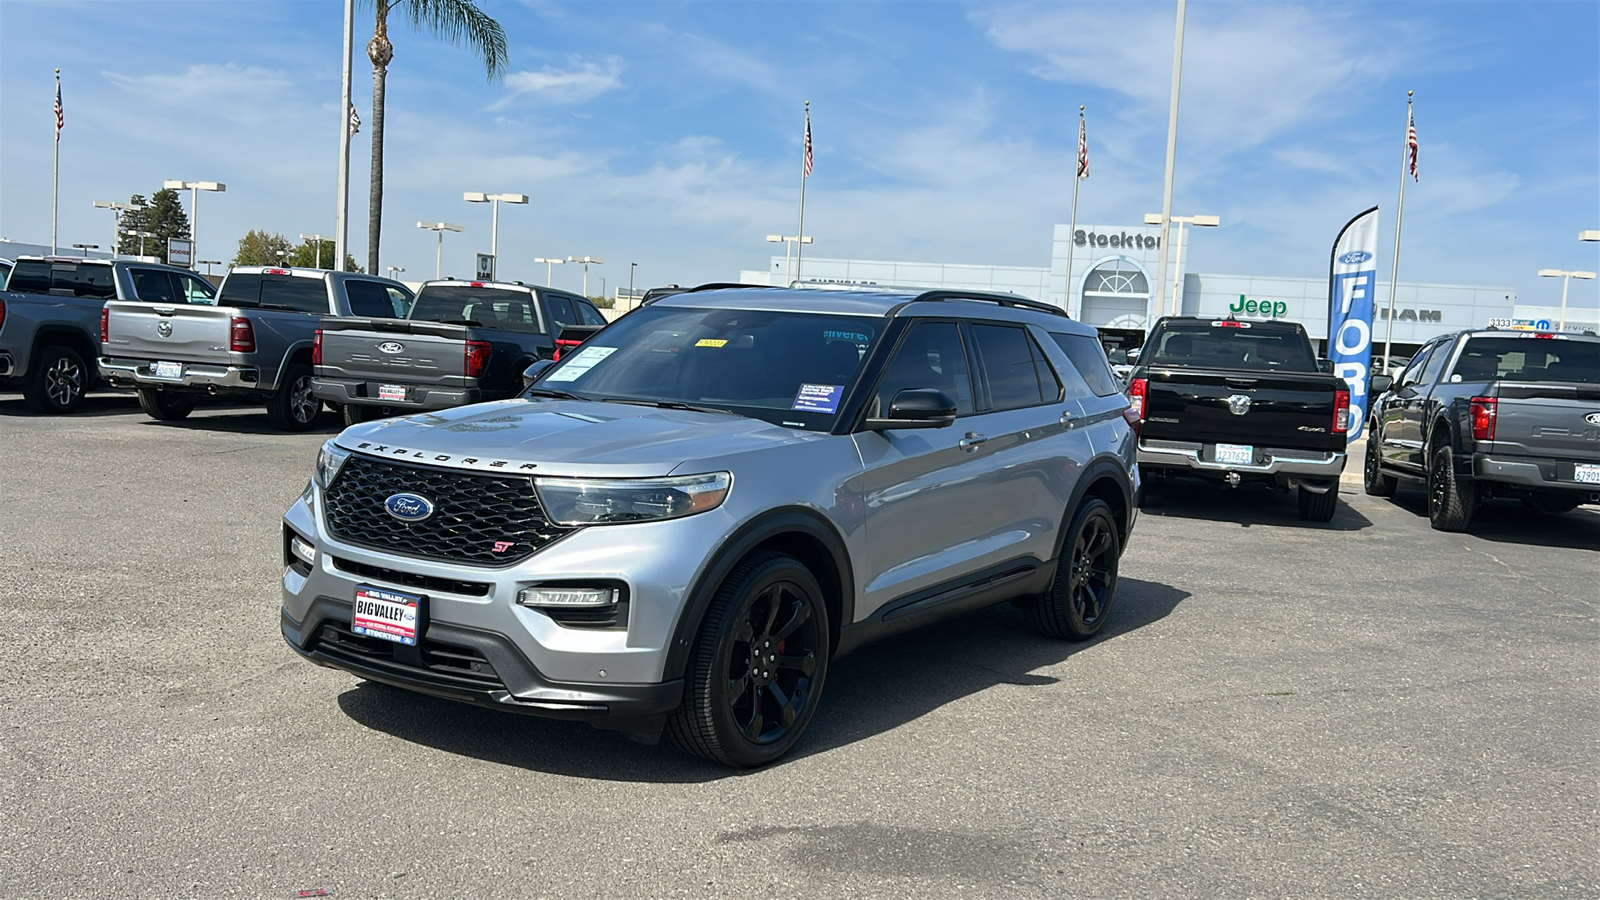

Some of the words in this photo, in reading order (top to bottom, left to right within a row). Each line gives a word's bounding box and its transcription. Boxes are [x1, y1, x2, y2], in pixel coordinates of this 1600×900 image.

[1074, 229, 1161, 249] Stockto
[1229, 294, 1287, 318] Jeep
[1381, 308, 1442, 322] RAM
[1490, 318, 1511, 327] 3333
[1555, 323, 1594, 331] Srvice
[1531, 425, 1600, 442] F-1
[357, 442, 538, 470] EXPLORER
[492, 541, 515, 552] ST
[380, 593, 404, 603] VALLEY
[357, 600, 405, 622] BIGVALLEY
[365, 628, 402, 642] STOCKTON
